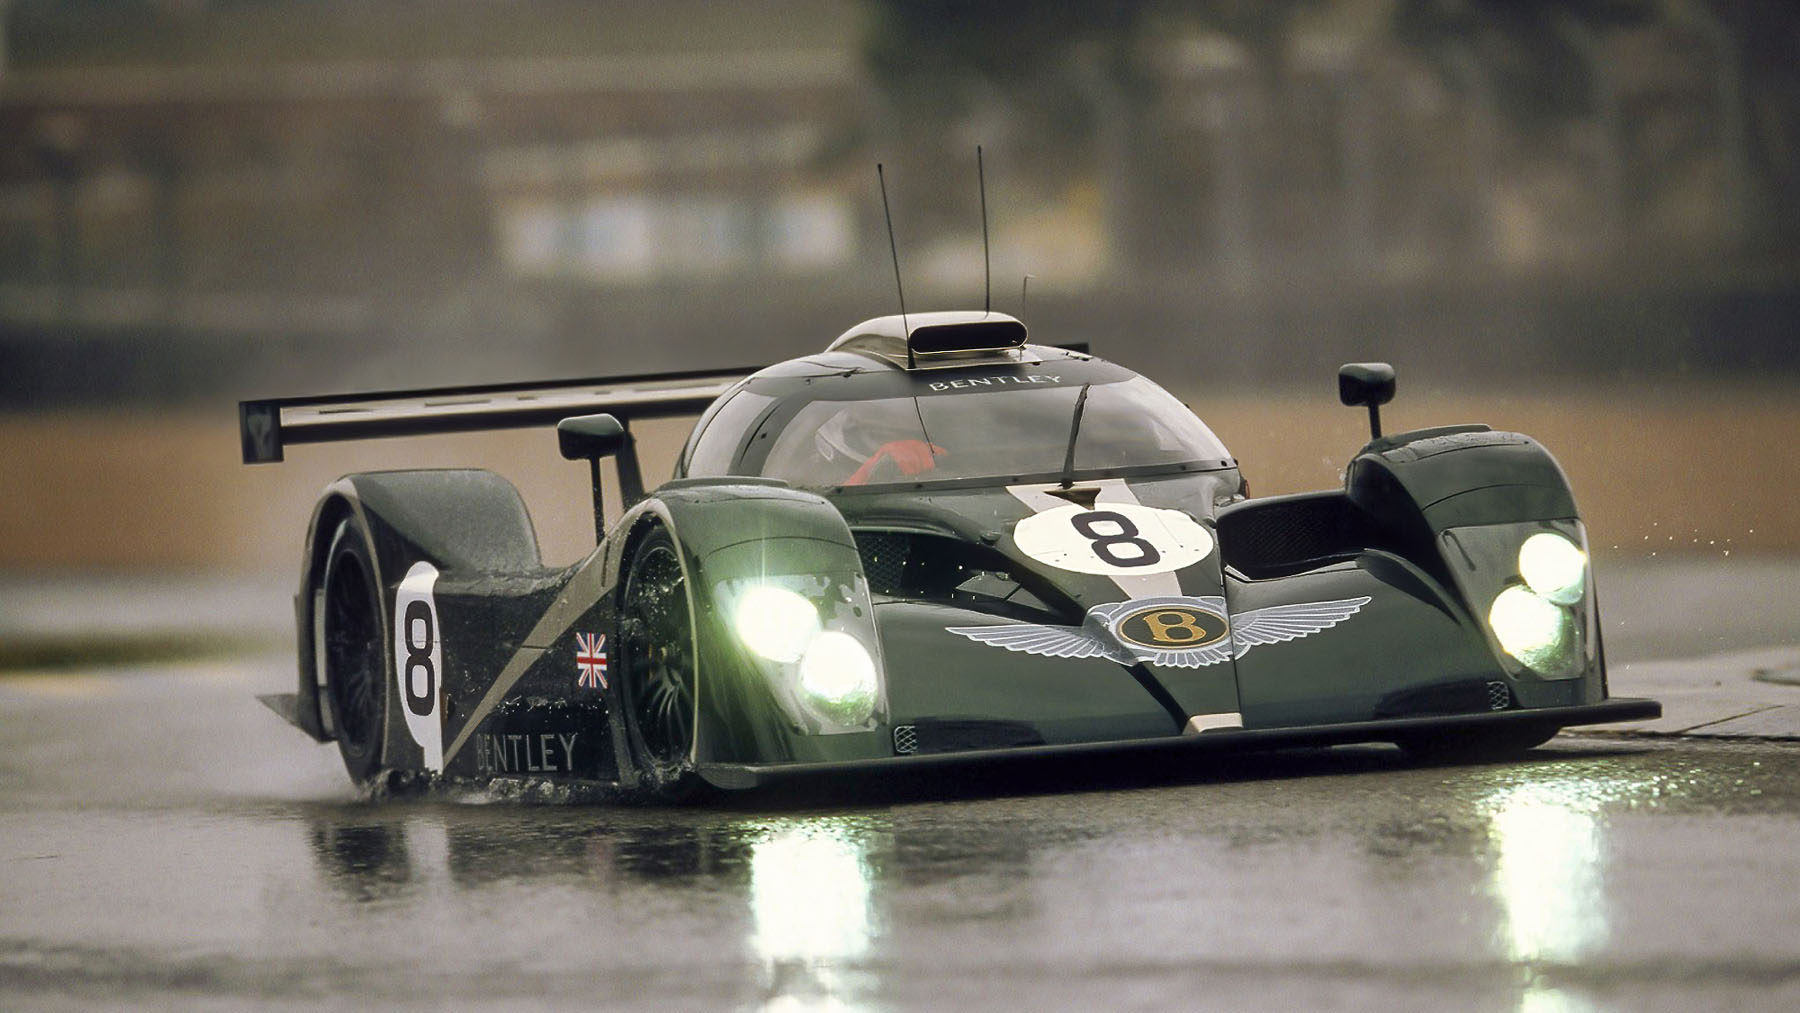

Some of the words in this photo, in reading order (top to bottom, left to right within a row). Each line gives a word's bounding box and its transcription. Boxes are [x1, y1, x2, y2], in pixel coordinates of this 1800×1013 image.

[929, 375, 1060, 391] BENTLEY
[1071, 511, 1161, 567] 8
[1143, 611, 1207, 642] B
[404, 600, 435, 716] 8
[476, 733, 578, 772] BENTLEY
